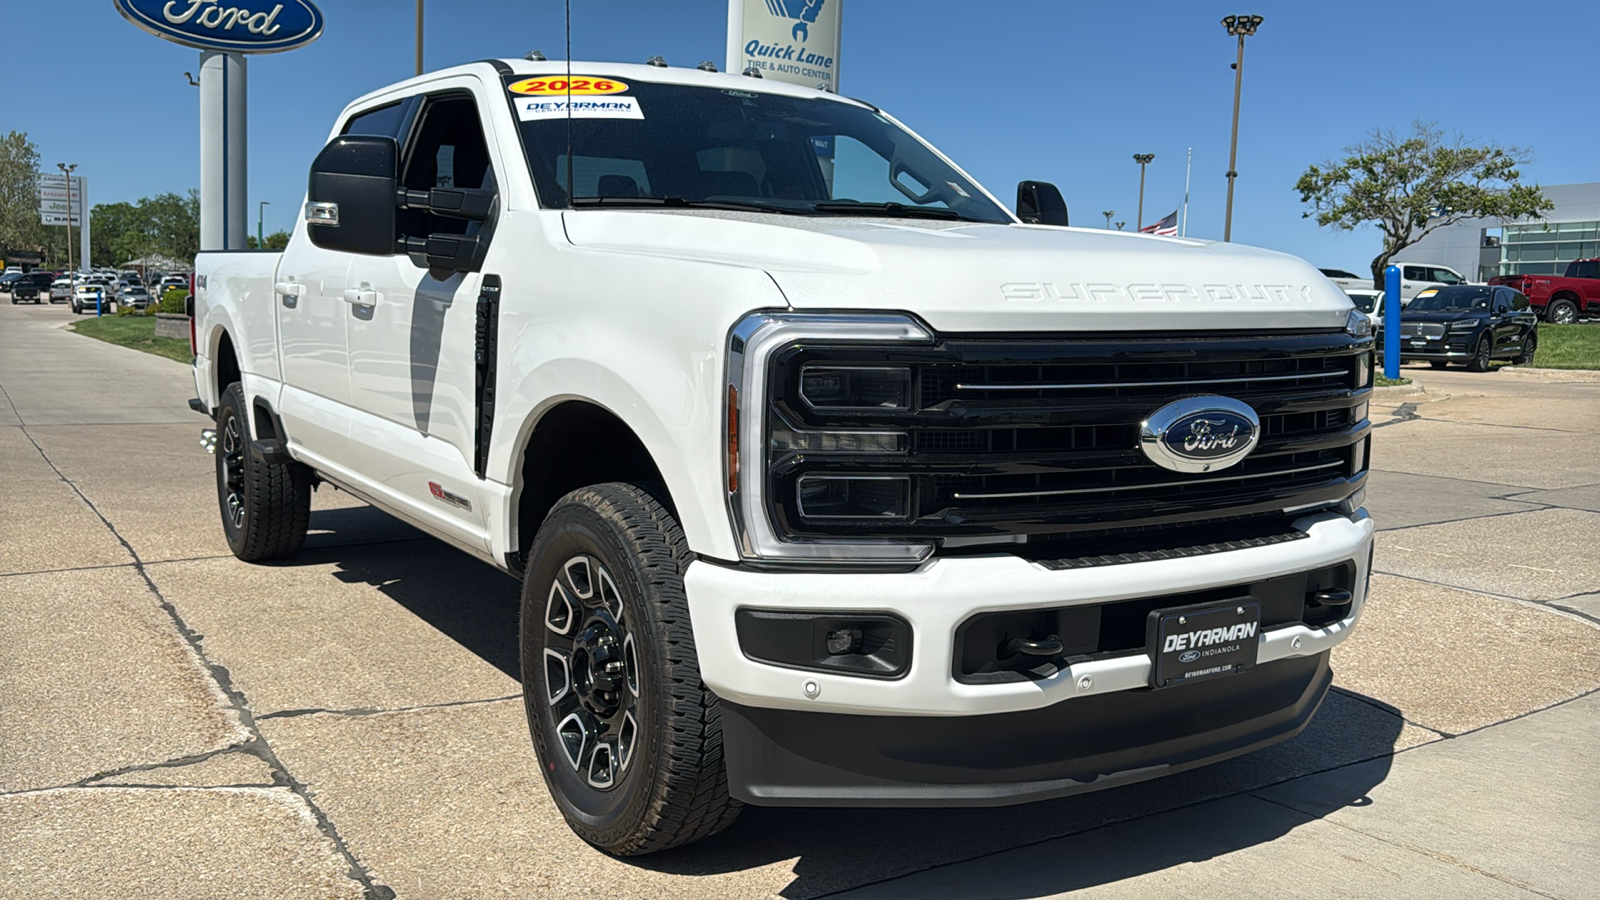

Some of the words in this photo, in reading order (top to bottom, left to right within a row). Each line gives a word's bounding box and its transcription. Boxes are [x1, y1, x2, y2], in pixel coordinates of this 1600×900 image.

[163, 0, 283, 36] Ford
[745, 39, 795, 60] Quick
[796, 48, 833, 68] Lane
[747, 59, 767, 70] TIRE
[769, 63, 775, 71] &
[777, 64, 800, 75] AUTO
[801, 67, 831, 81] CENTER
[525, 80, 614, 92] 2026
[526, 102, 631, 110] DEYARMAN
[1000, 282, 1199, 302] SUPER
[1203, 284, 1313, 302] DUTY
[1184, 419, 1238, 452] Ford
[1163, 621, 1258, 653] DEYARMAN
[1202, 644, 1240, 657] INDIANOLA
